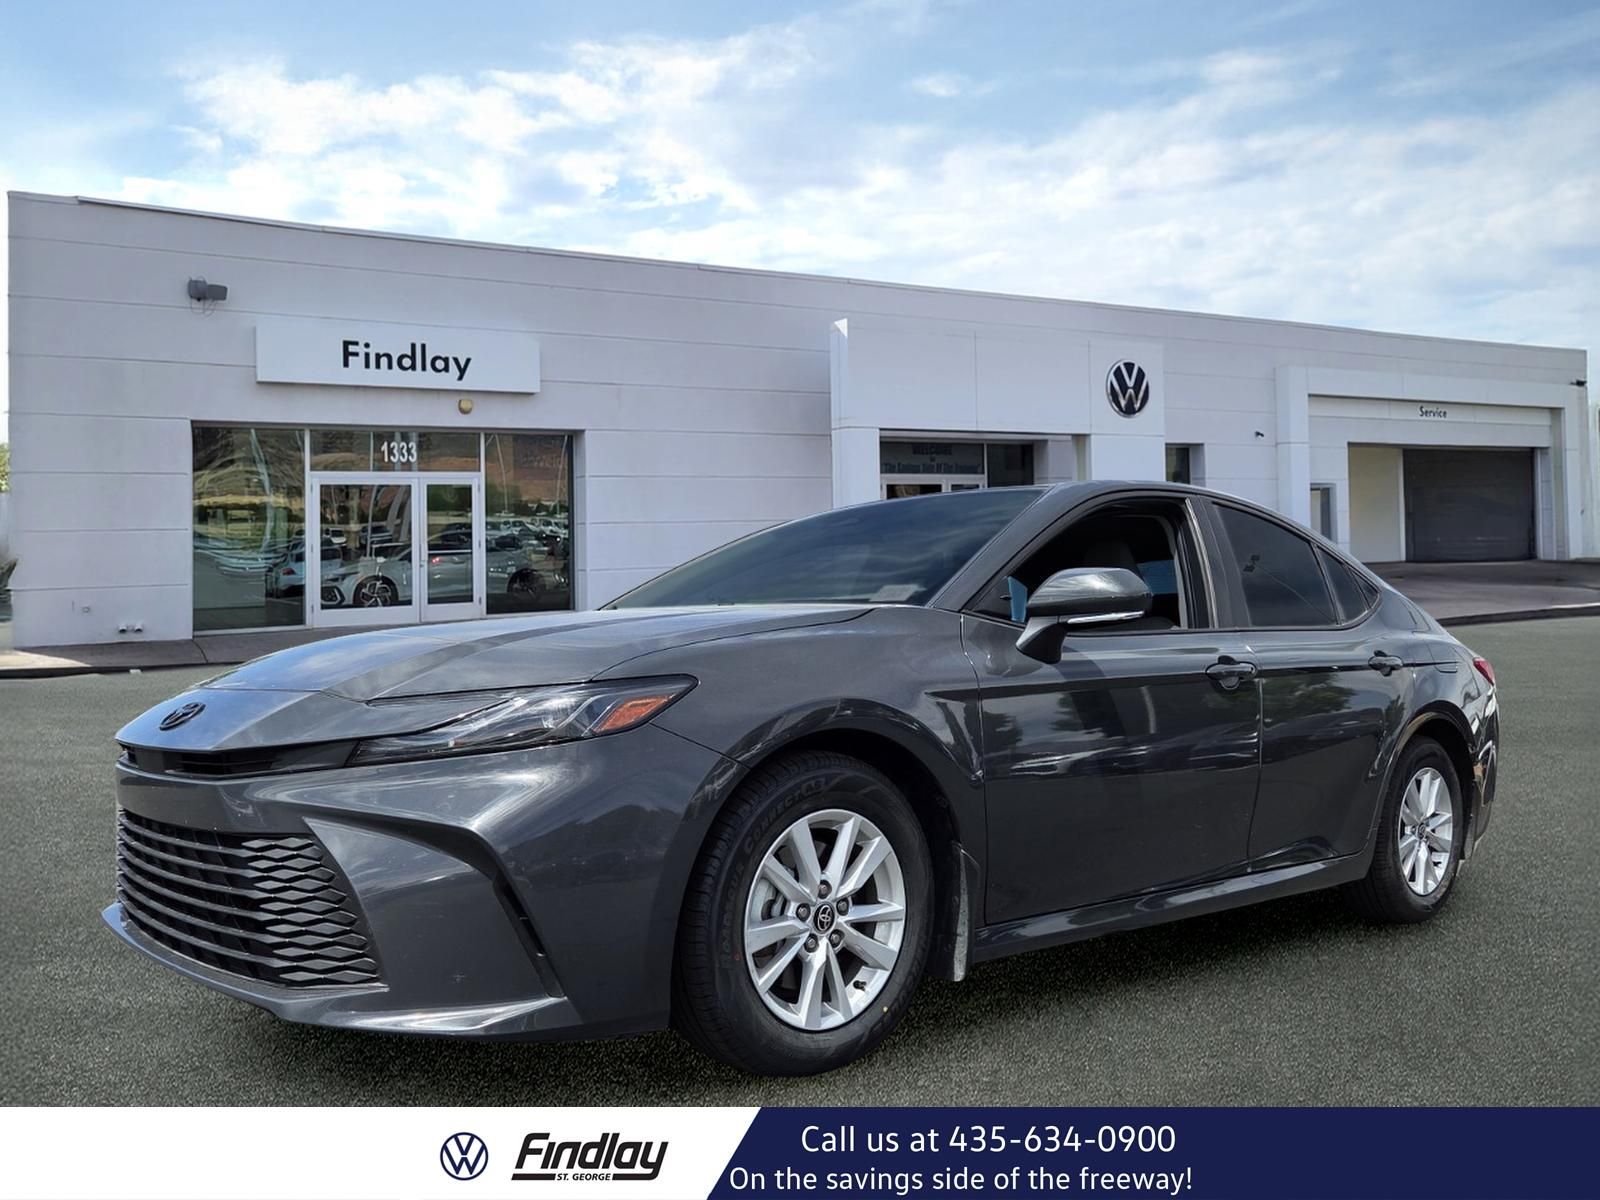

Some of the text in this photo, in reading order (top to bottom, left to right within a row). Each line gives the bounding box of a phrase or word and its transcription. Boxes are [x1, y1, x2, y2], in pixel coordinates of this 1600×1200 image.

[341, 339, 472, 381] Findlay
[1419, 405, 1448, 419] Service
[381, 441, 418, 464] 1333
